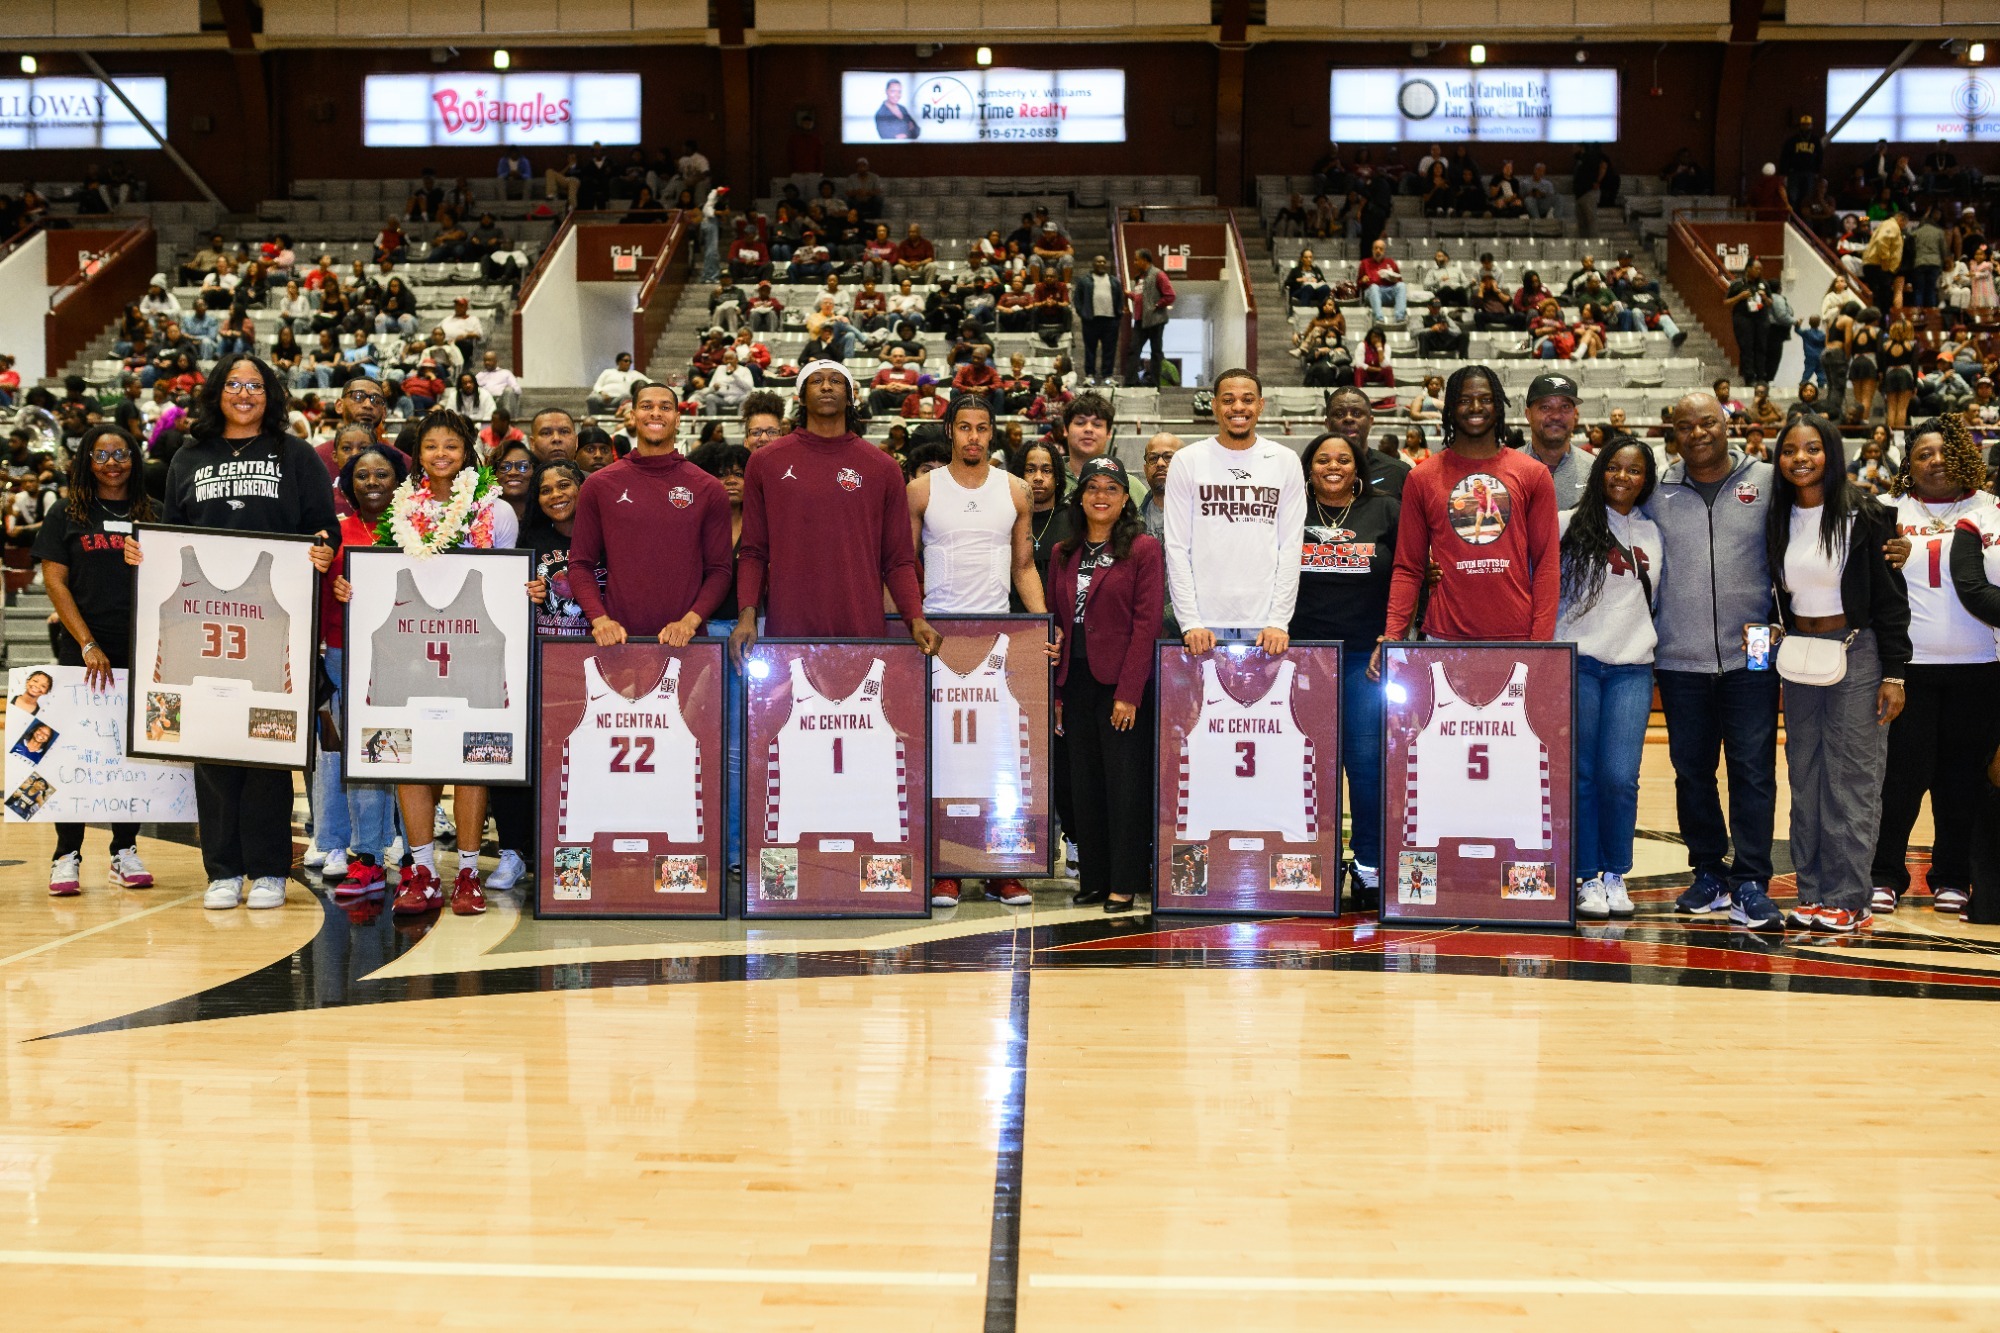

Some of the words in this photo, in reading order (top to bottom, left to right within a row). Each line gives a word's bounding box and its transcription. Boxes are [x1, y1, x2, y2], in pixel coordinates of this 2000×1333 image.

[977, 88, 1026, 99] Kimberly
[1030, 88, 1040, 98] V.
[1043, 88, 1092, 98] Williams
[1444, 81, 1475, 98] North
[1477, 81, 1524, 98] Carolina
[432, 88, 571, 133] Bojangles
[922, 104, 961, 124] Right
[977, 103, 1014, 119] Time
[1019, 102, 1068, 120] Realty
[1516, 101, 1553, 118] Throat
[979, 128, 1058, 138] 919-672-0889
[1506, 126, 1536, 135] Practice
[194, 465, 213, 482] NC
[196, 480, 230, 502] WOMEN'S
[233, 479, 279, 499] BASKETBALL
[1199, 484, 1264, 501] UNITY
[1263, 487, 1280, 505] IS
[1201, 502, 1277, 522] STRENGTH
[1301, 555, 1371, 567] EAGLES
[1477, 559, 1499, 568] BUTTS
[1926, 538, 1943, 588] 1
[182, 598, 201, 615] NC
[205, 600, 265, 620] CENTRAL
[398, 618, 415, 634] NC
[420, 618, 480, 635] CENTRAL
[537, 626, 555, 635] CHRIS
[557, 628, 586, 636] DANIELS
[200, 622, 248, 661] 33
[425, 640, 451, 679] 4
[63, 683, 128, 707] Tiern
[947, 687, 999, 704] CENTRAL
[596, 713, 612, 729] NC
[616, 712, 669, 729] CENTRAL
[800, 714, 816, 731] NC
[819, 713, 874, 730] CENTRAL
[952, 708, 977, 745] 11
[1208, 718, 1224, 734] NC
[1228, 717, 1283, 734] CENTRAL
[1440, 720, 1457, 736] NC
[1460, 719, 1517, 737] CENTRAL
[609, 736, 656, 774] 22
[832, 736, 844, 775] 1
[1235, 740, 1256, 778] 3
[1467, 743, 1490, 780] 5
[58, 765, 148, 786] Coleman
[69, 796, 152, 814] T-MONEY
